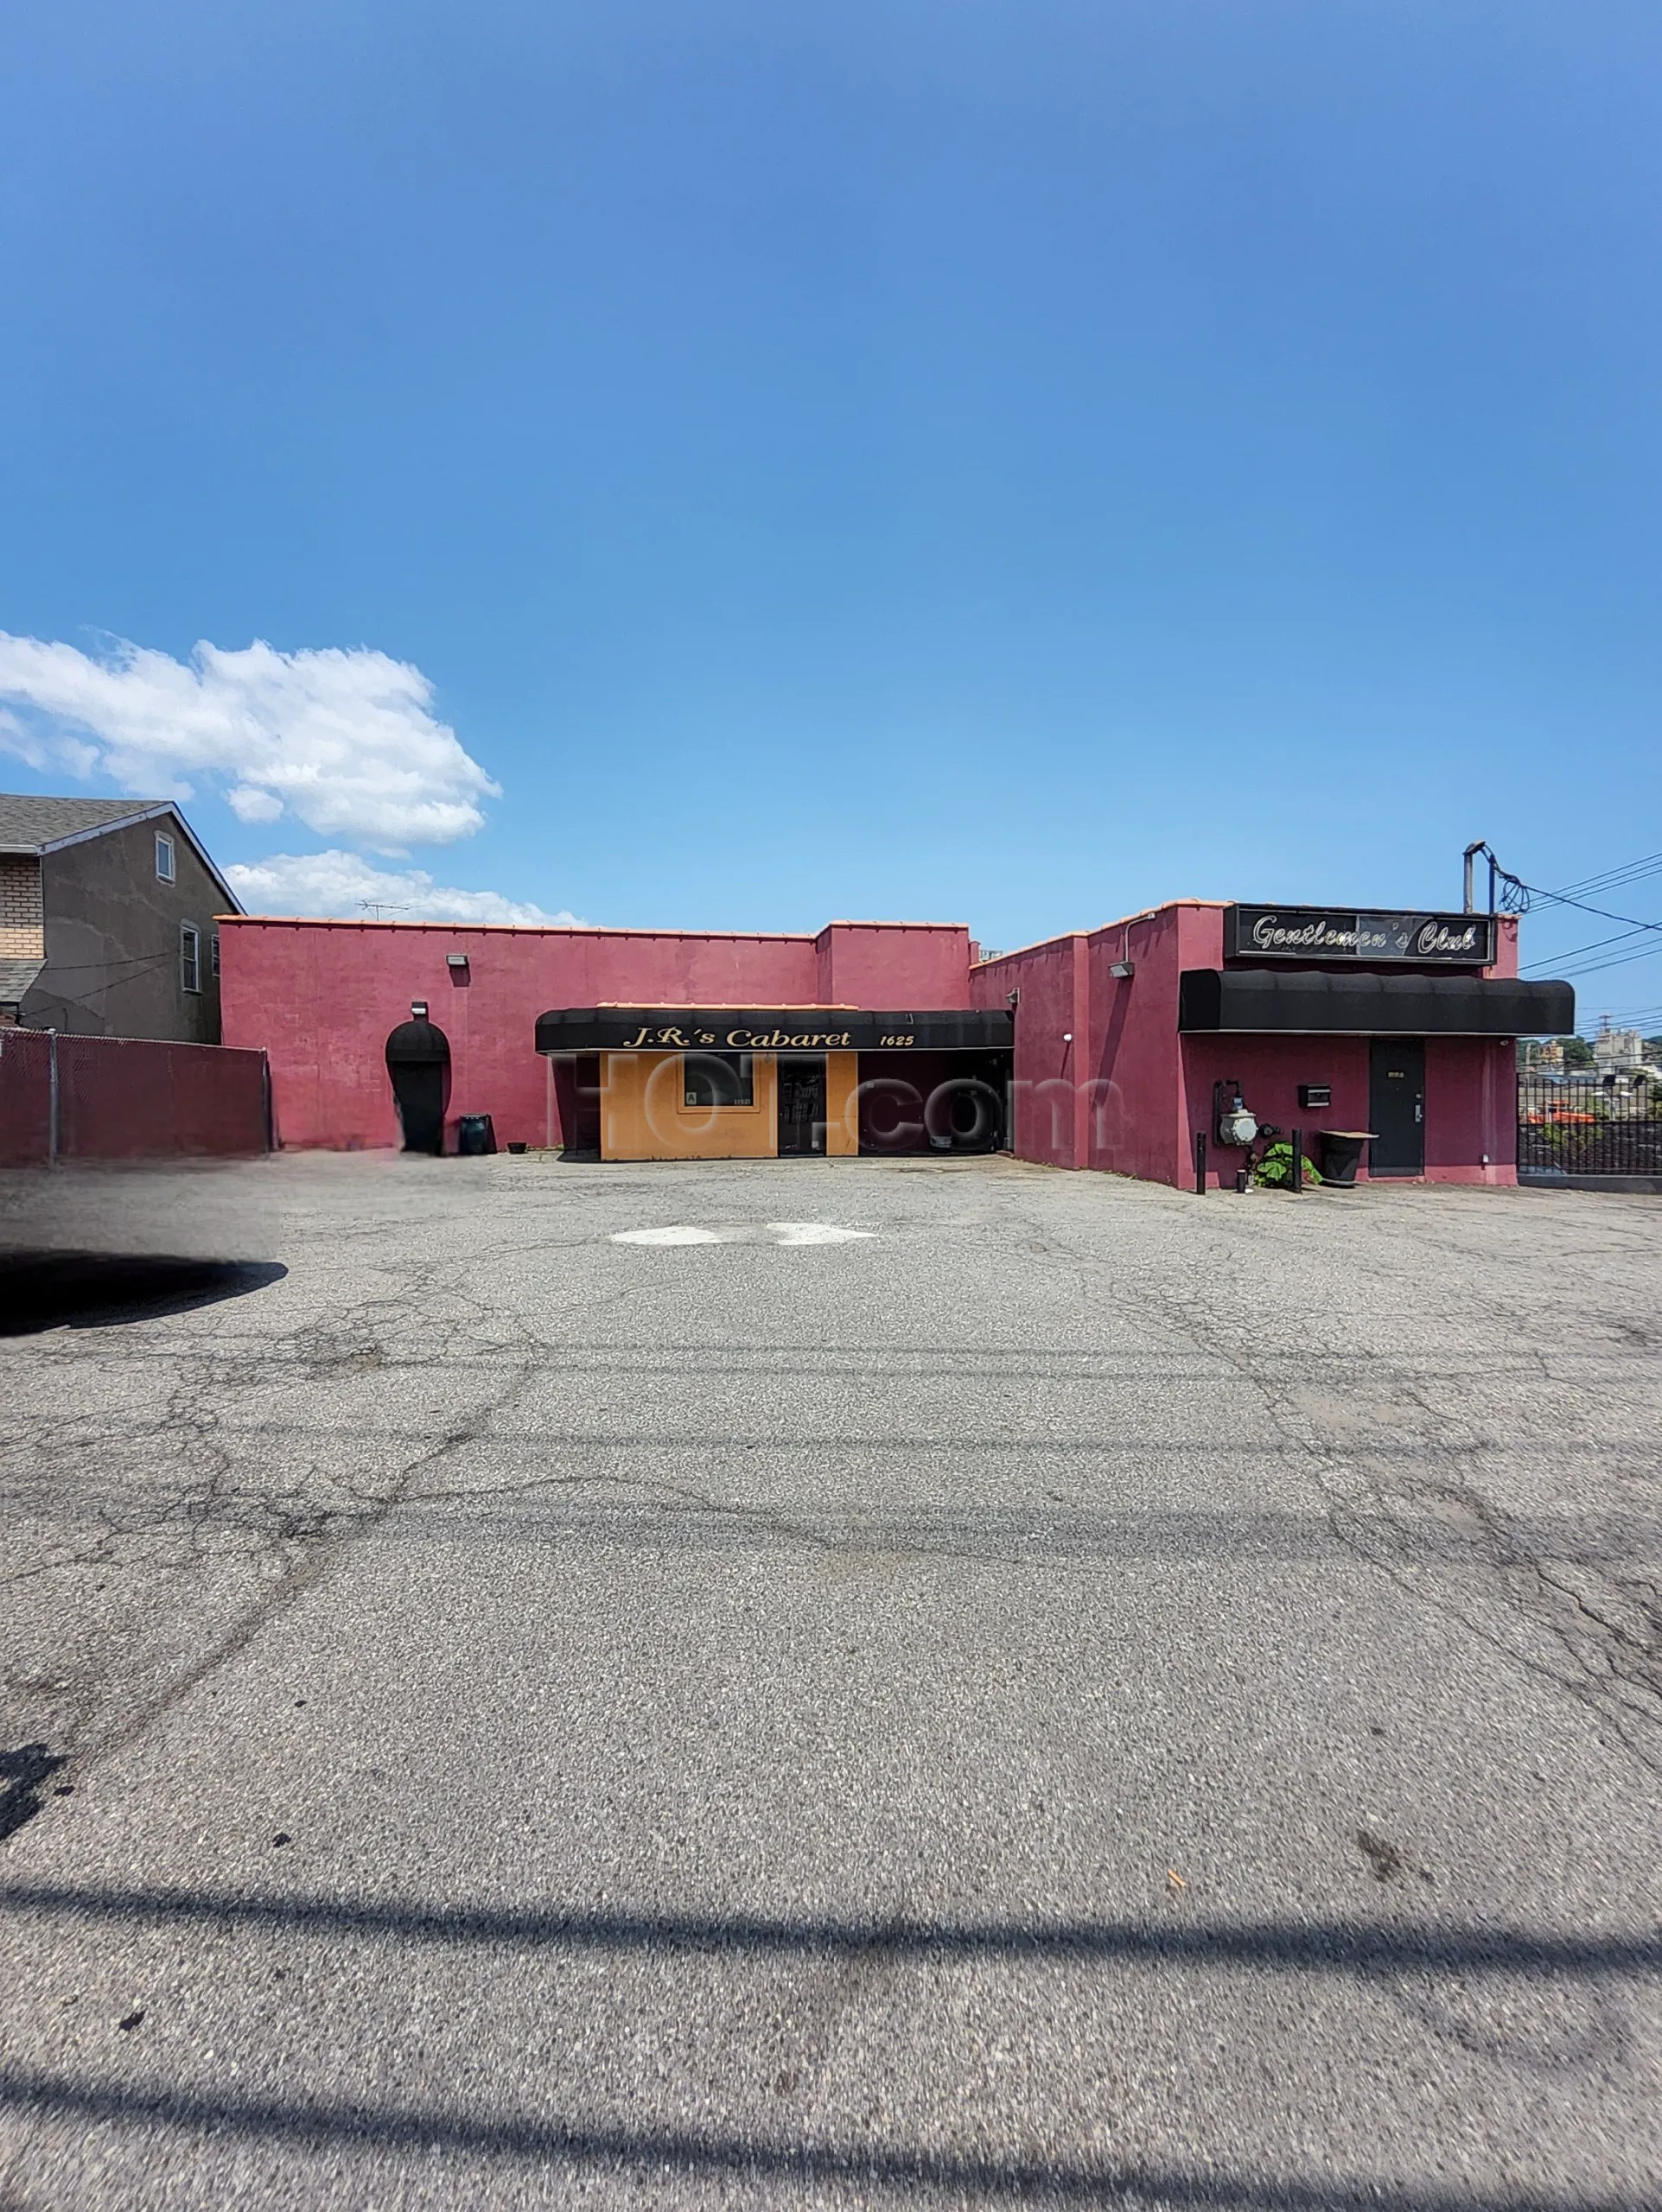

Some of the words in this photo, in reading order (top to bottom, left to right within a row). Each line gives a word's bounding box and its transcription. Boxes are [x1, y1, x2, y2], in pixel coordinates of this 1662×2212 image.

[1253, 915, 1410, 949] Gentlemen's
[1417, 921, 1476, 954] Club
[622, 1026, 716, 1047] J.R.'s
[726, 1029, 850, 1047] Cabaret
[880, 1035, 914, 1046] 1625
